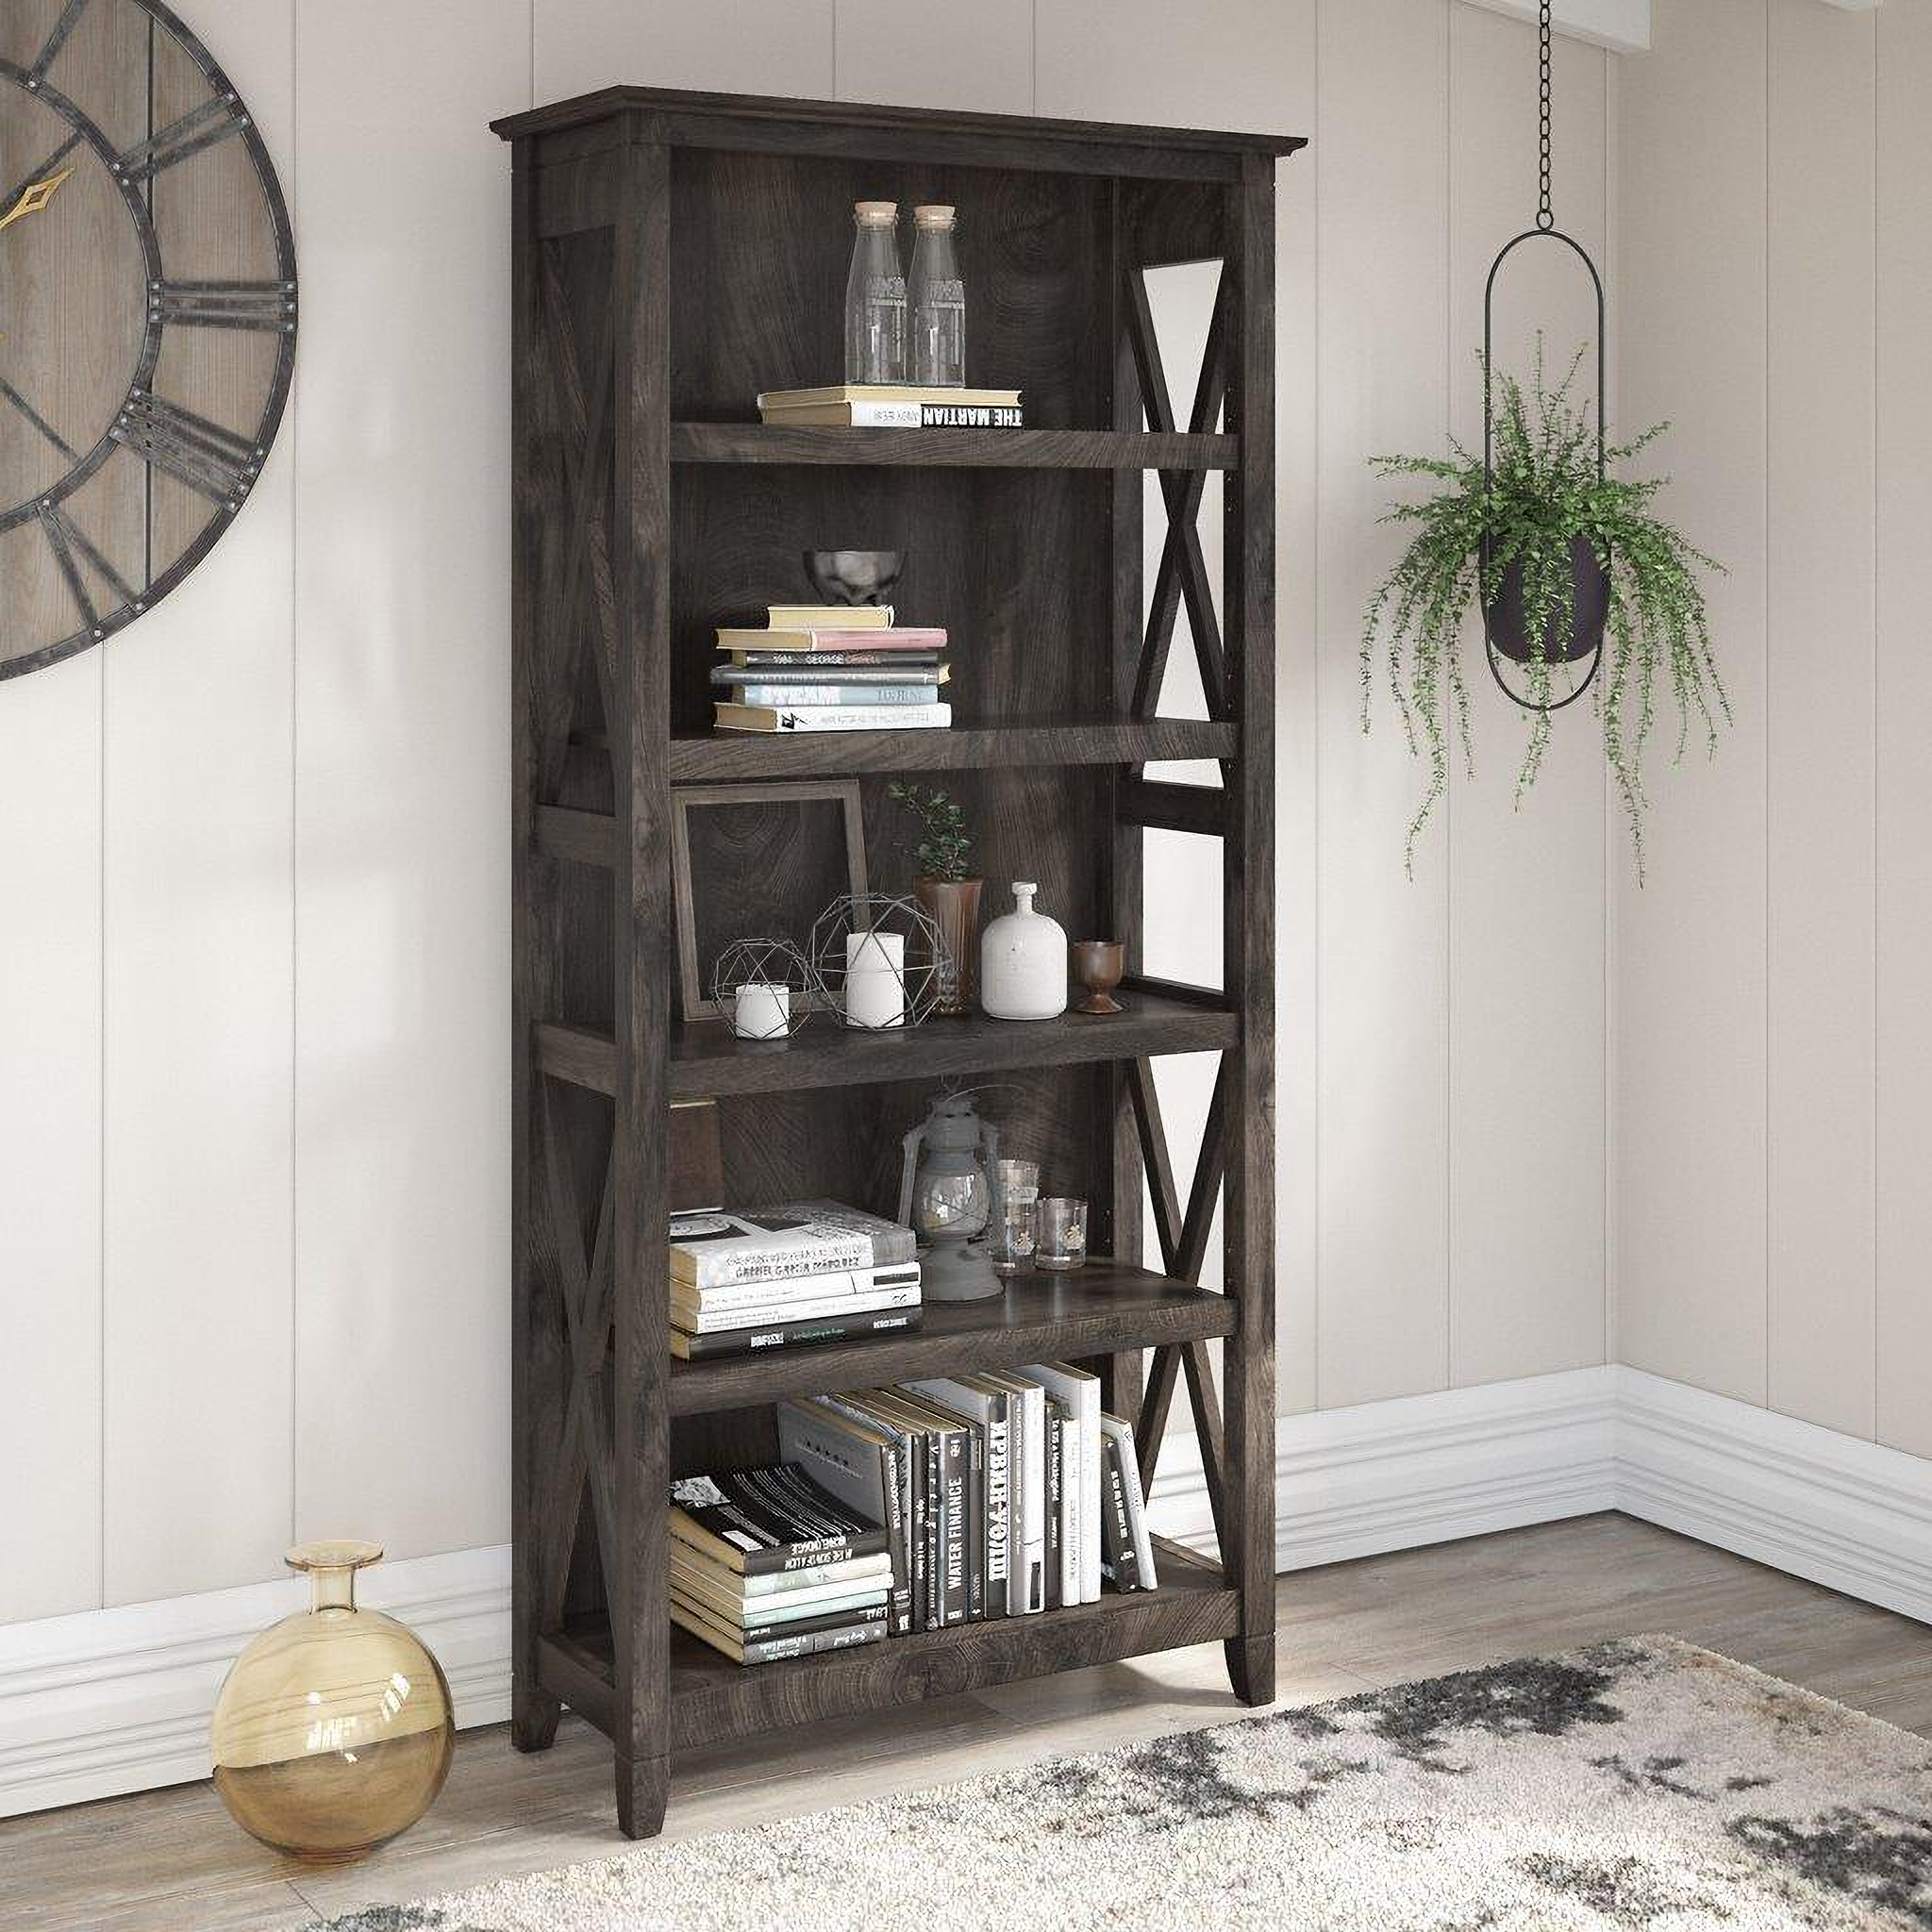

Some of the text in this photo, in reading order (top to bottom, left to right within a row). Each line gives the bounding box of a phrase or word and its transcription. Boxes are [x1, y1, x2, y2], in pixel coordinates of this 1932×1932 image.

[923, 408, 991, 425] MARTIAN
[994, 408, 1022, 426] THE
[948, 1476, 963, 1537] FINANCE
[947, 1541, 963, 1591] WATER
